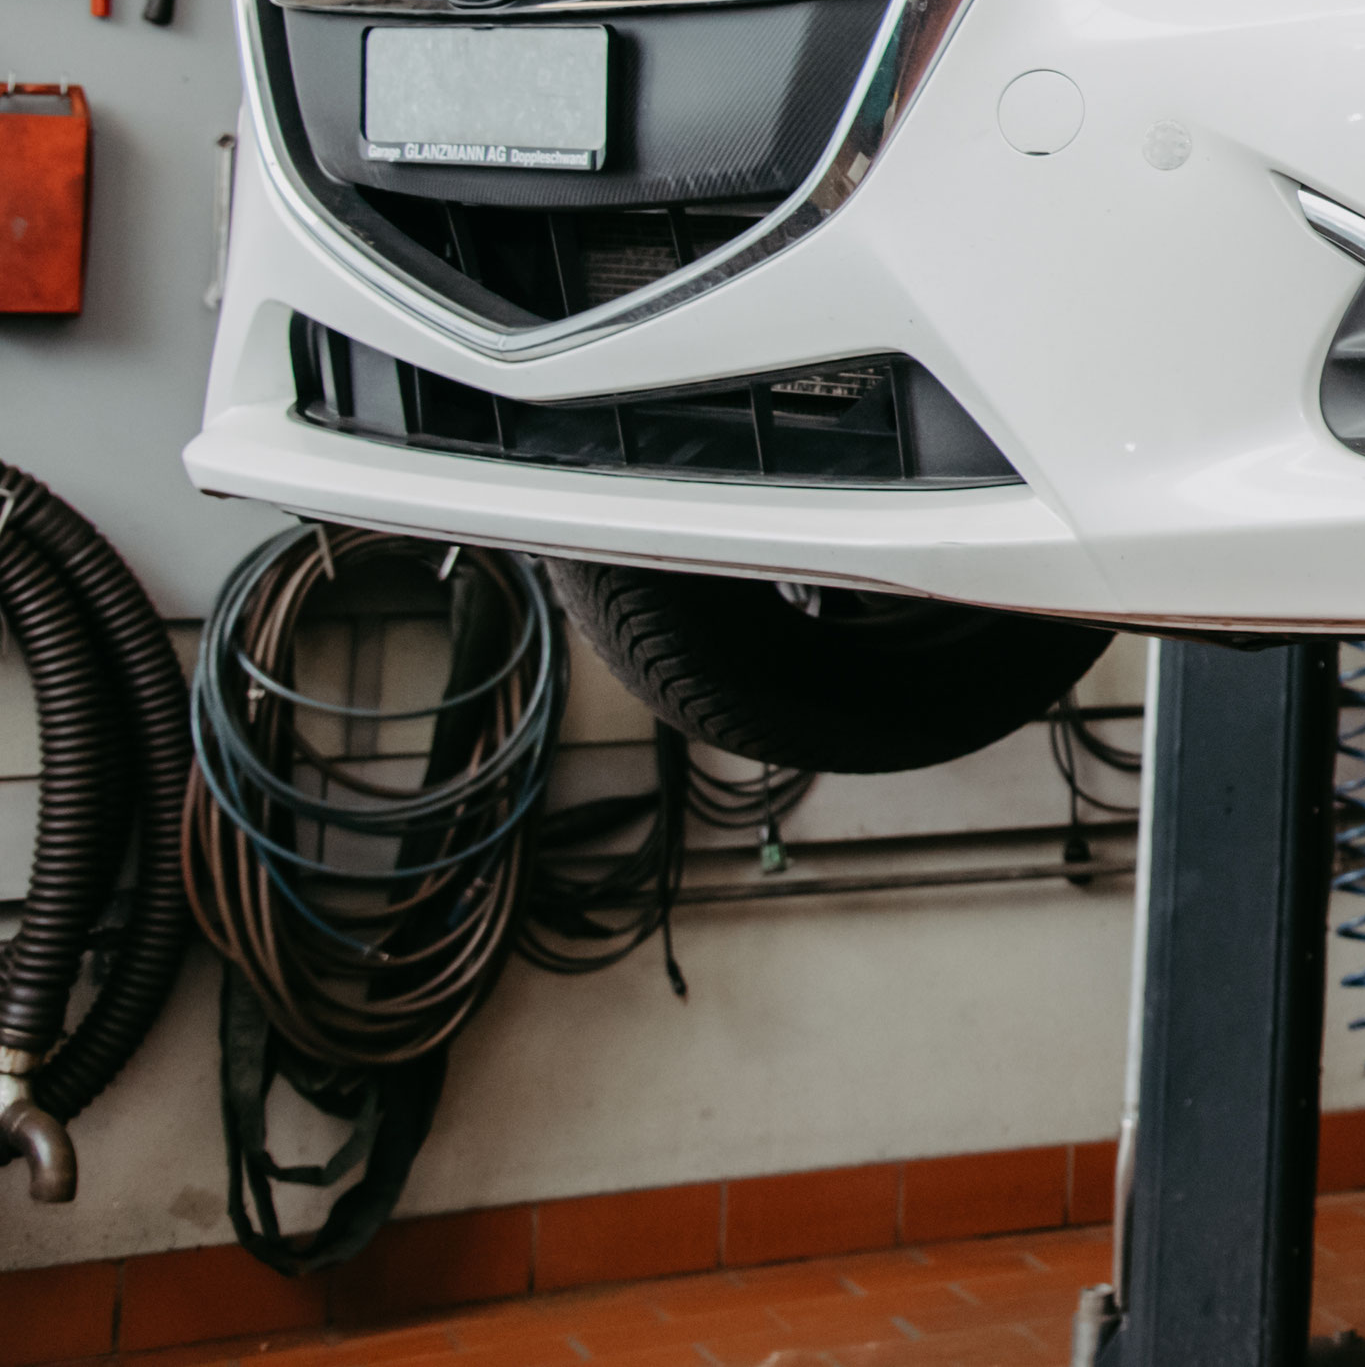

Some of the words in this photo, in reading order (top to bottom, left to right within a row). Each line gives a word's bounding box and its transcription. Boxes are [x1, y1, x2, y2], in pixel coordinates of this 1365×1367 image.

[367, 143, 401, 162] Garage
[404, 142, 485, 162] GLANZMANN
[487, 146, 507, 163] AG
[510, 148, 589, 167] Doppleschwand
